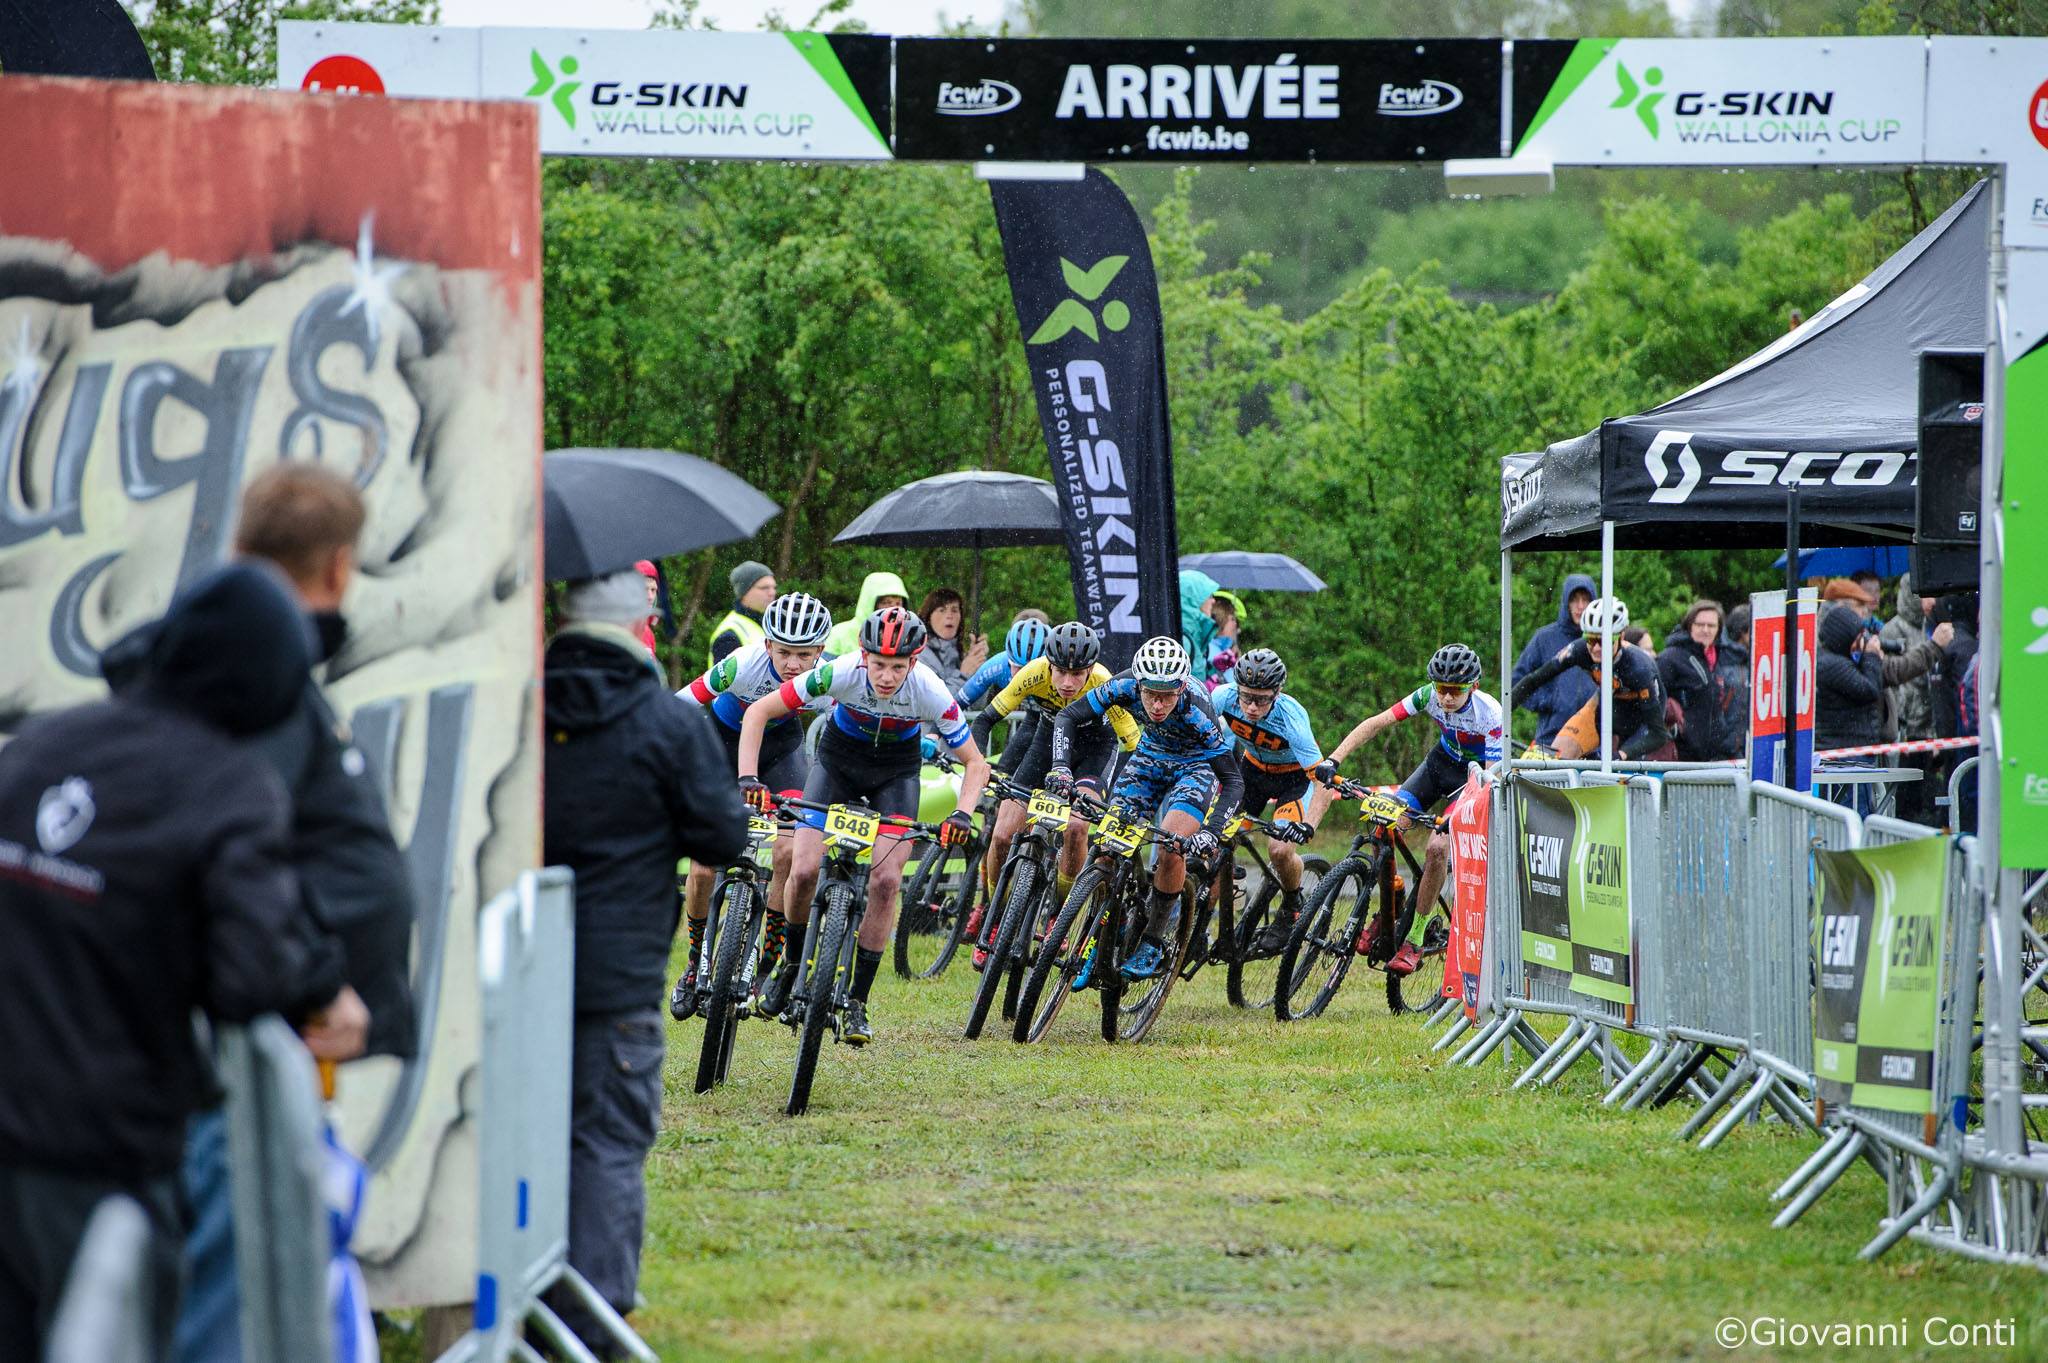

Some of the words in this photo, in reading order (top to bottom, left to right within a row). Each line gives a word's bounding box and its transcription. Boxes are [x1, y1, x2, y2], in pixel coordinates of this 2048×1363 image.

[591, 83, 748, 108] G-SKIN
[938, 82, 999, 105] Fcwb
[1055, 53, 1340, 118] ARRIVÉE
[1379, 83, 1440, 106] Fcwb
[1675, 92, 1834, 116] G-SKIN
[592, 111, 746, 136] WALLONIA
[754, 114, 814, 138] CUP
[1675, 119, 1831, 143] WALLONIA
[1839, 119, 1901, 142] CUP
[1146, 125, 1250, 151] fcwb.be
[1046, 368, 1089, 520] PERSONALIZED
[1709, 450, 1918, 487] SCO
[1065, 359, 1142, 634] G-SKIN
[1035, 801, 1064, 817] 601
[833, 815, 870, 837] 648
[1529, 833, 1564, 879] G-SKIN
[1586, 842, 1622, 888] G-SKIN
